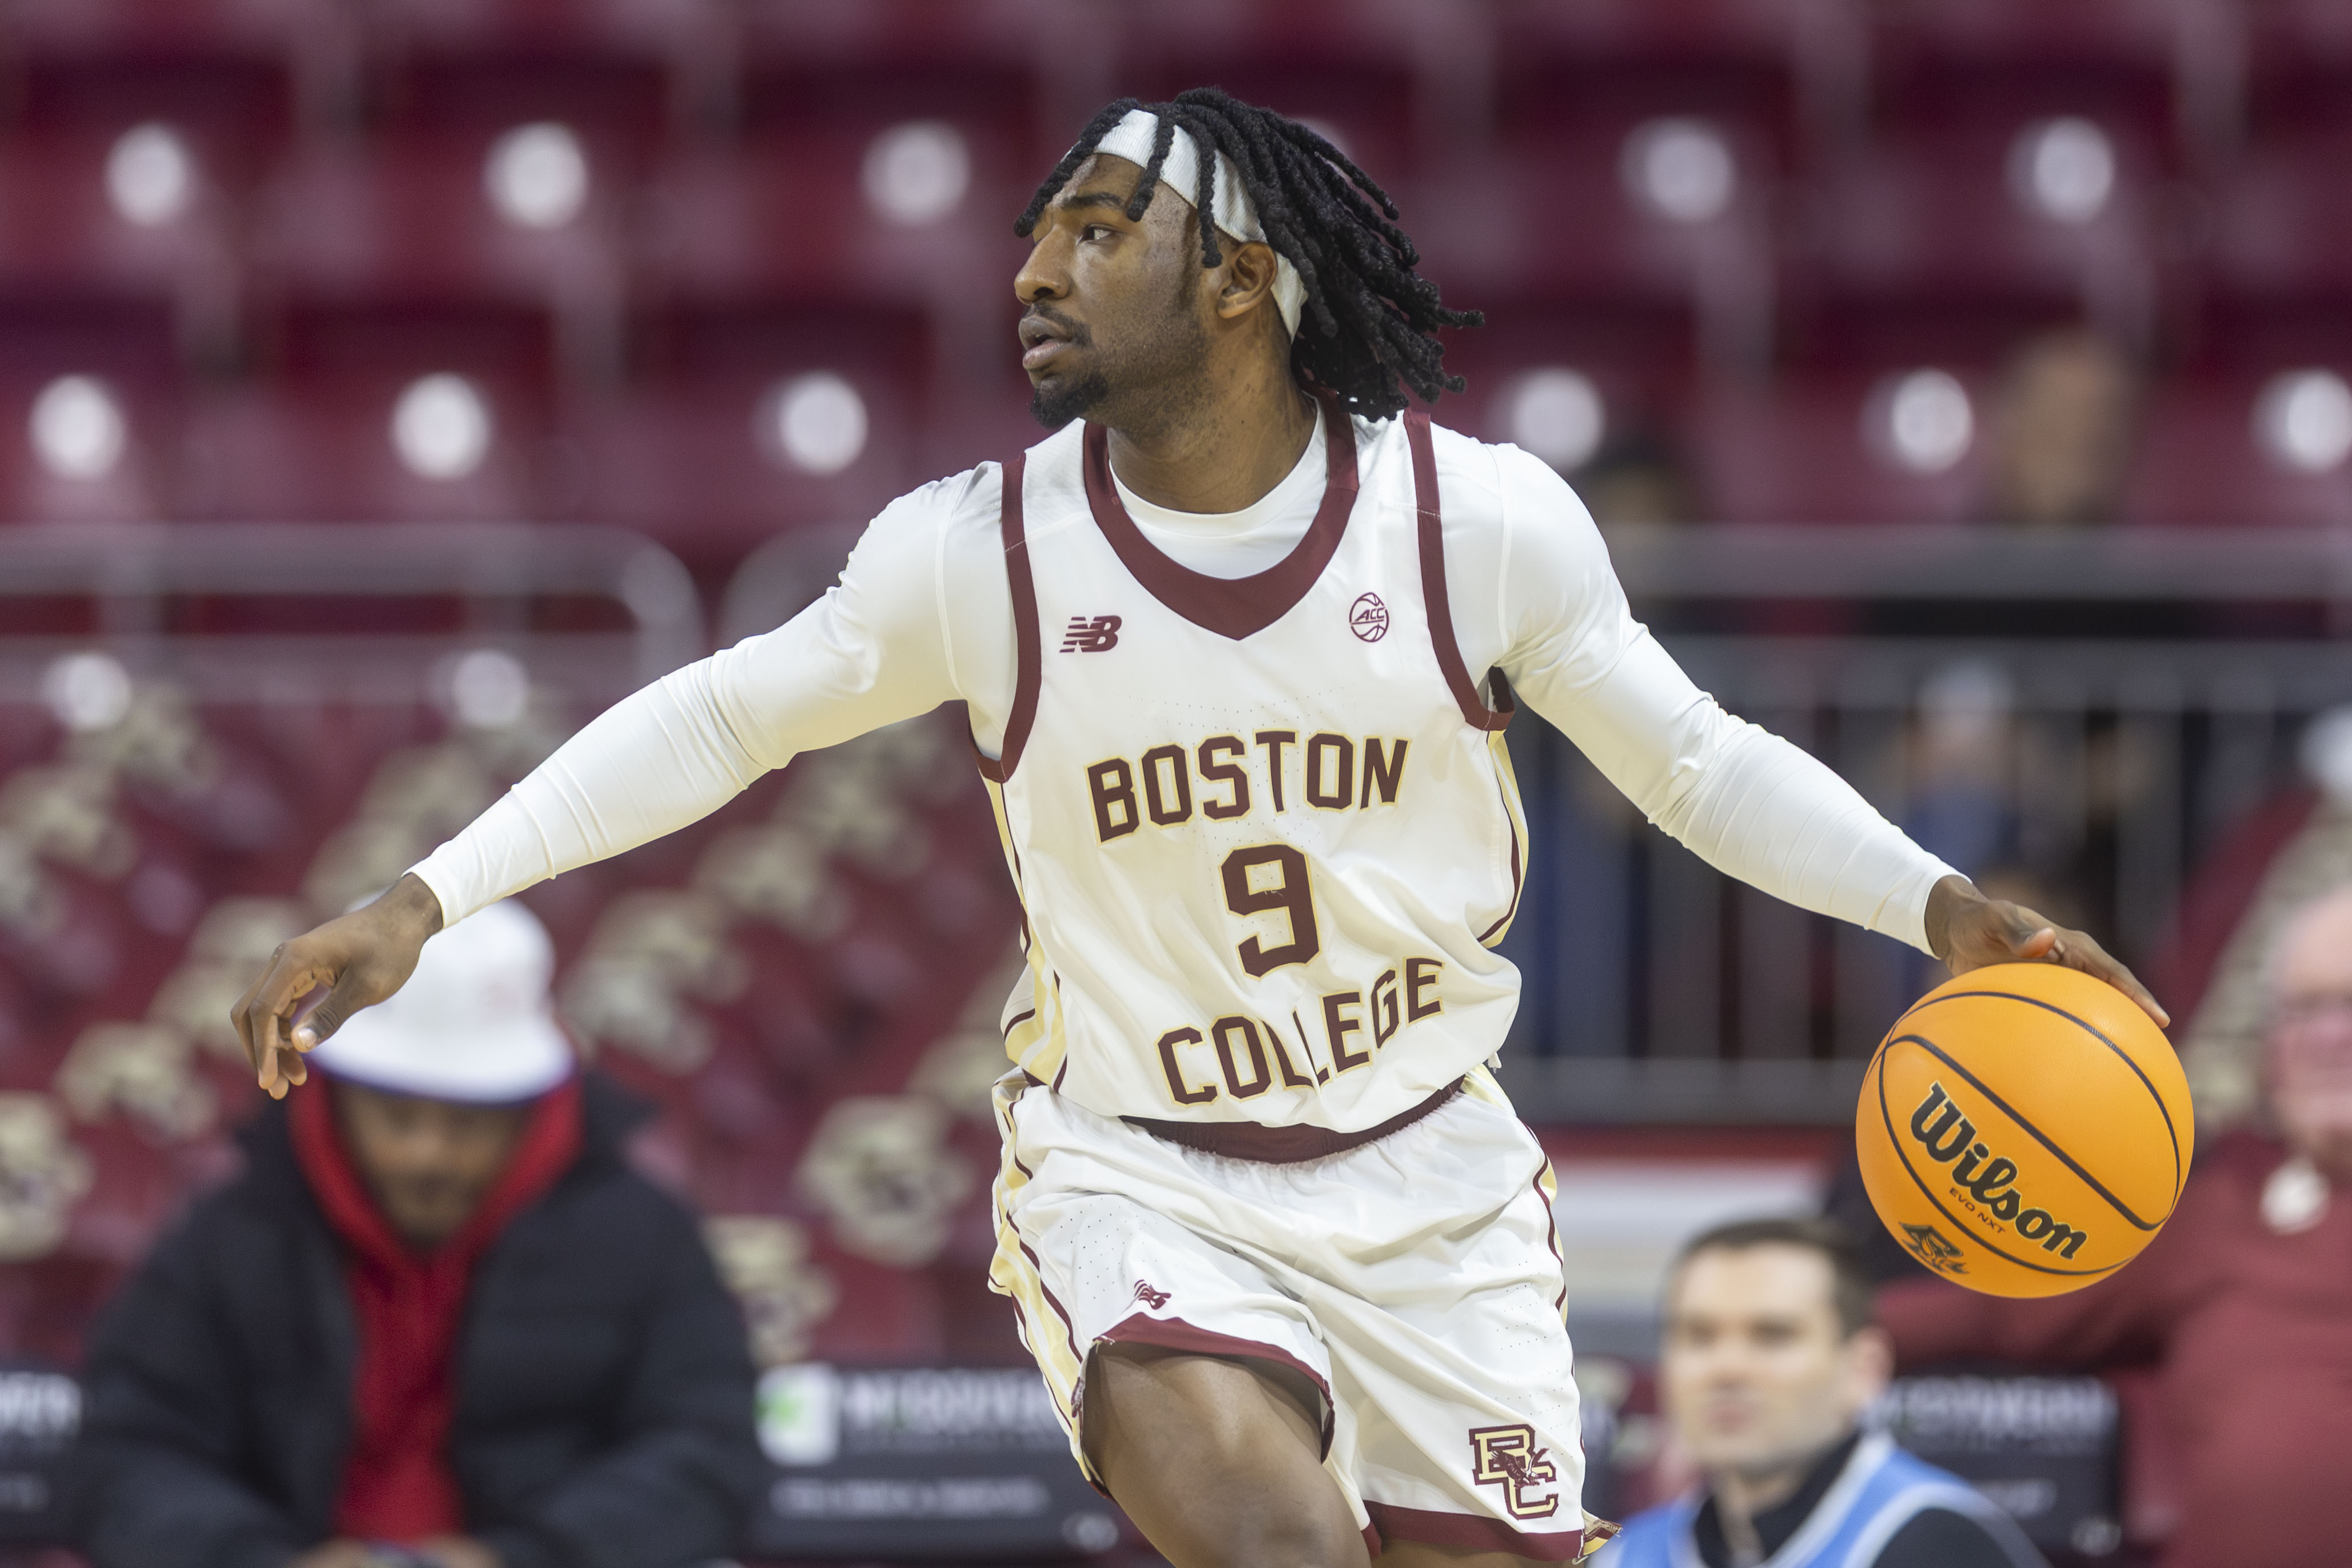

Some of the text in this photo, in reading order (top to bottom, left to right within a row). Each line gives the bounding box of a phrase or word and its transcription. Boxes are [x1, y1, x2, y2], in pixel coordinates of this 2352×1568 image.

[1059, 615, 1122, 652] NB
[1354, 607, 1385, 621] ACC
[1086, 730, 1410, 845] BOSTON
[1219, 843, 1320, 980] 9
[1911, 1080, 2087, 1260] Wilson
[1949, 1187, 2006, 1233] EVO NXT
[1469, 1424, 1558, 1520] BC
